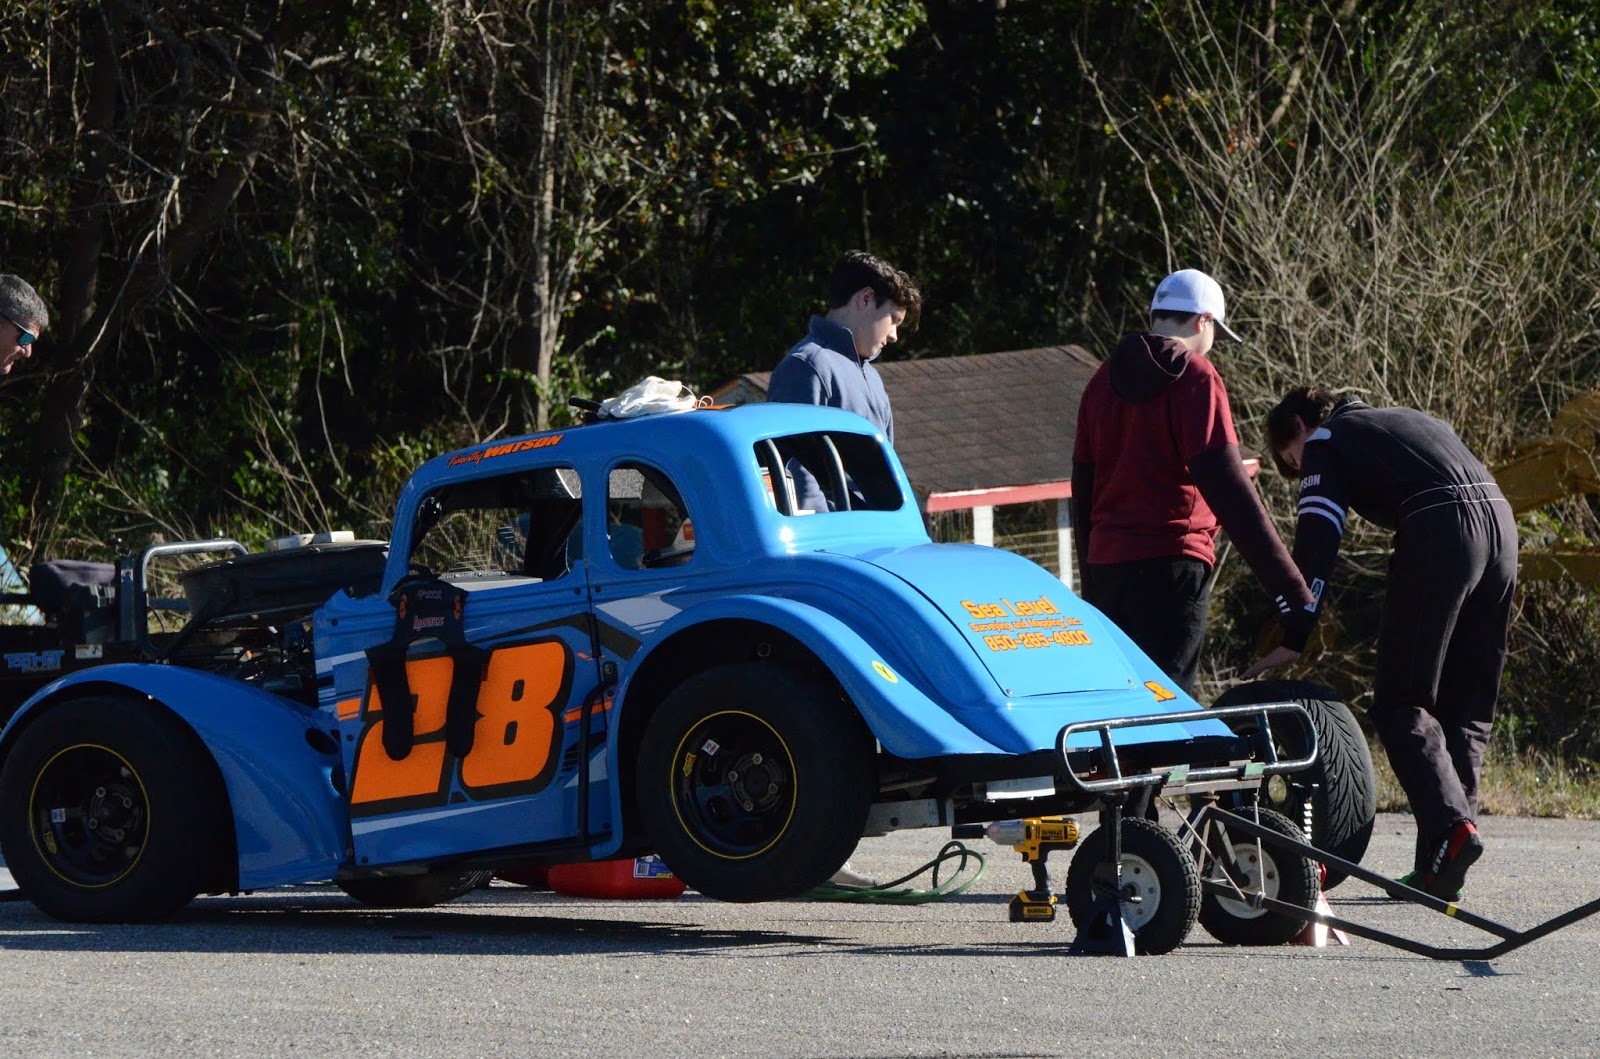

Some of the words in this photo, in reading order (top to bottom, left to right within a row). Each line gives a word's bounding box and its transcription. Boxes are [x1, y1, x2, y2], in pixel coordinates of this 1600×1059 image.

[482, 434, 564, 459] WATSON
[1300, 474, 1321, 492] SON
[960, 600, 1008, 619] Sea
[1000, 595, 1061, 617] Level
[968, 622, 1014, 633] Surveying
[1012, 620, 1029, 630] and
[983, 629, 1092, 652] 850-265-4800
[350, 640, 568, 806] 28
